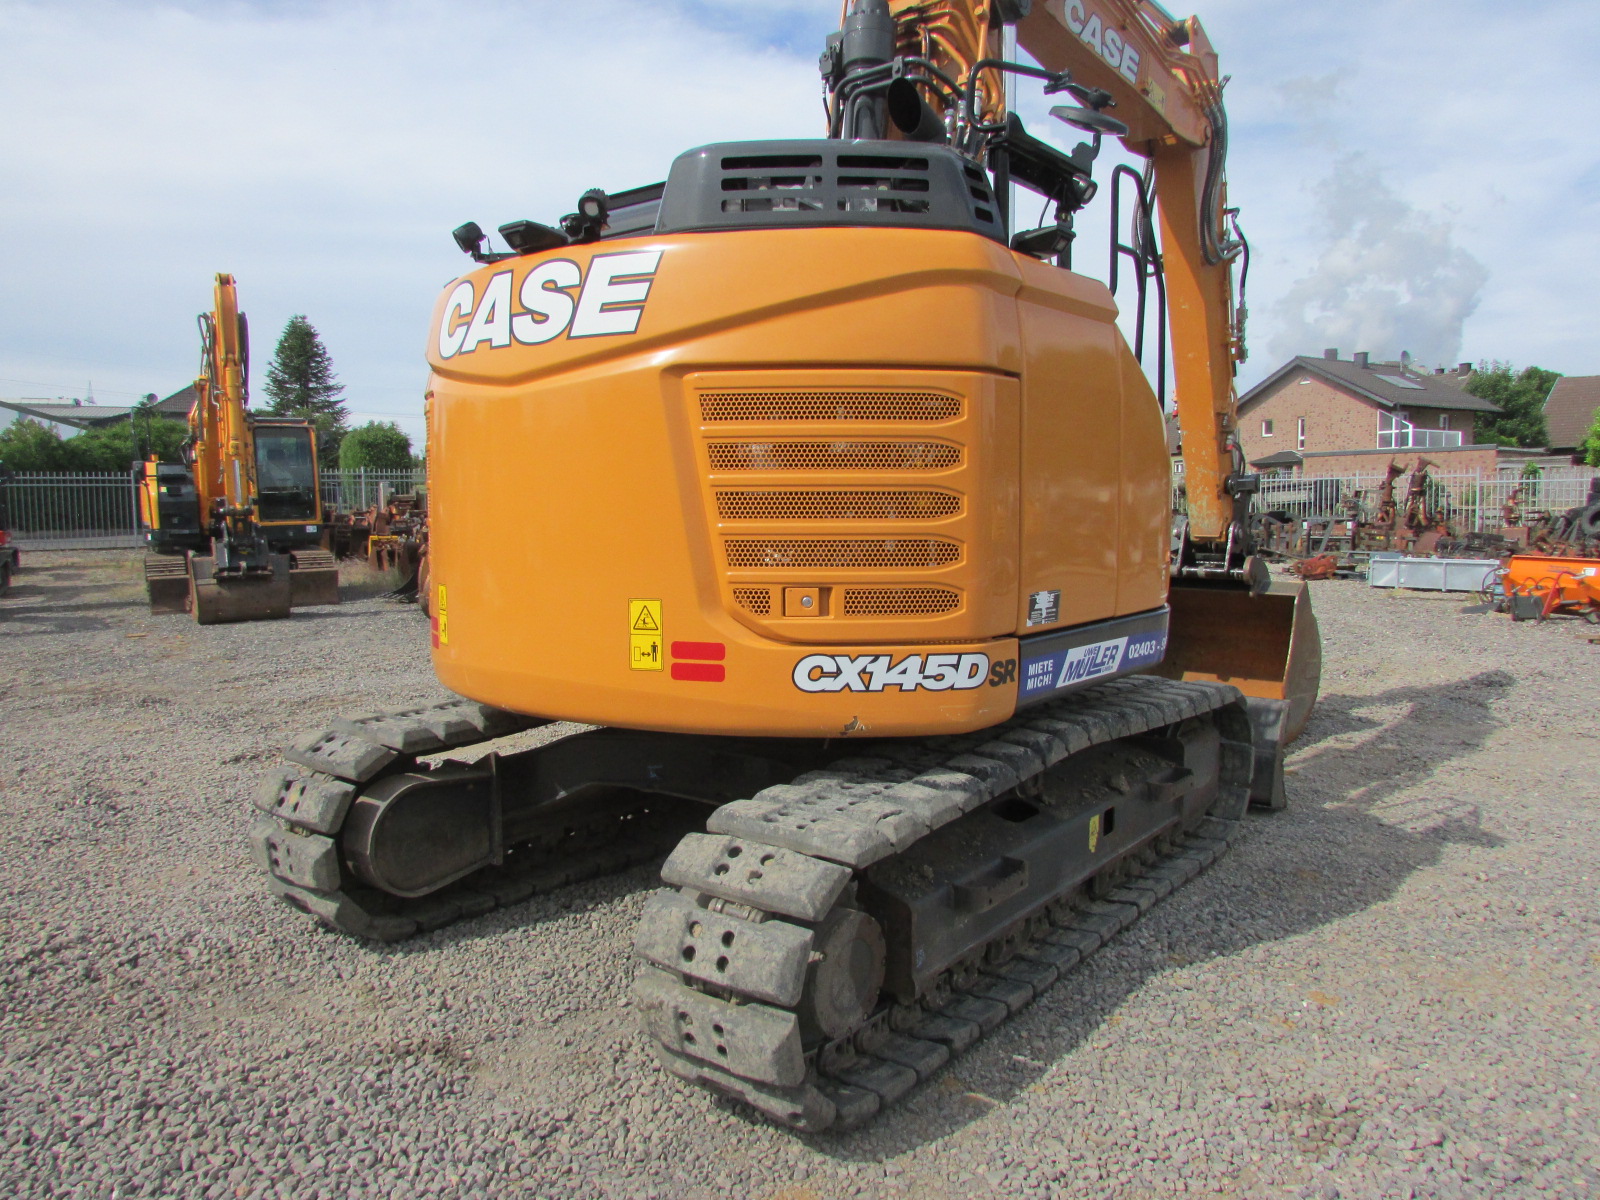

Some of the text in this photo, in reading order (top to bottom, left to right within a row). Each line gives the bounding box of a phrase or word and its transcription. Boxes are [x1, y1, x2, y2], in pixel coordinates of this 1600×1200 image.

[1064, 0, 1140, 85] CASE
[439, 250, 665, 360] CASE
[1084, 646, 1099, 657] UWE
[1129, 640, 1155, 659] 02403
[792, 652, 1017, 693] CX145D SR
[1028, 659, 1053, 676] MIETE
[1026, 673, 1052, 690] MICH!
